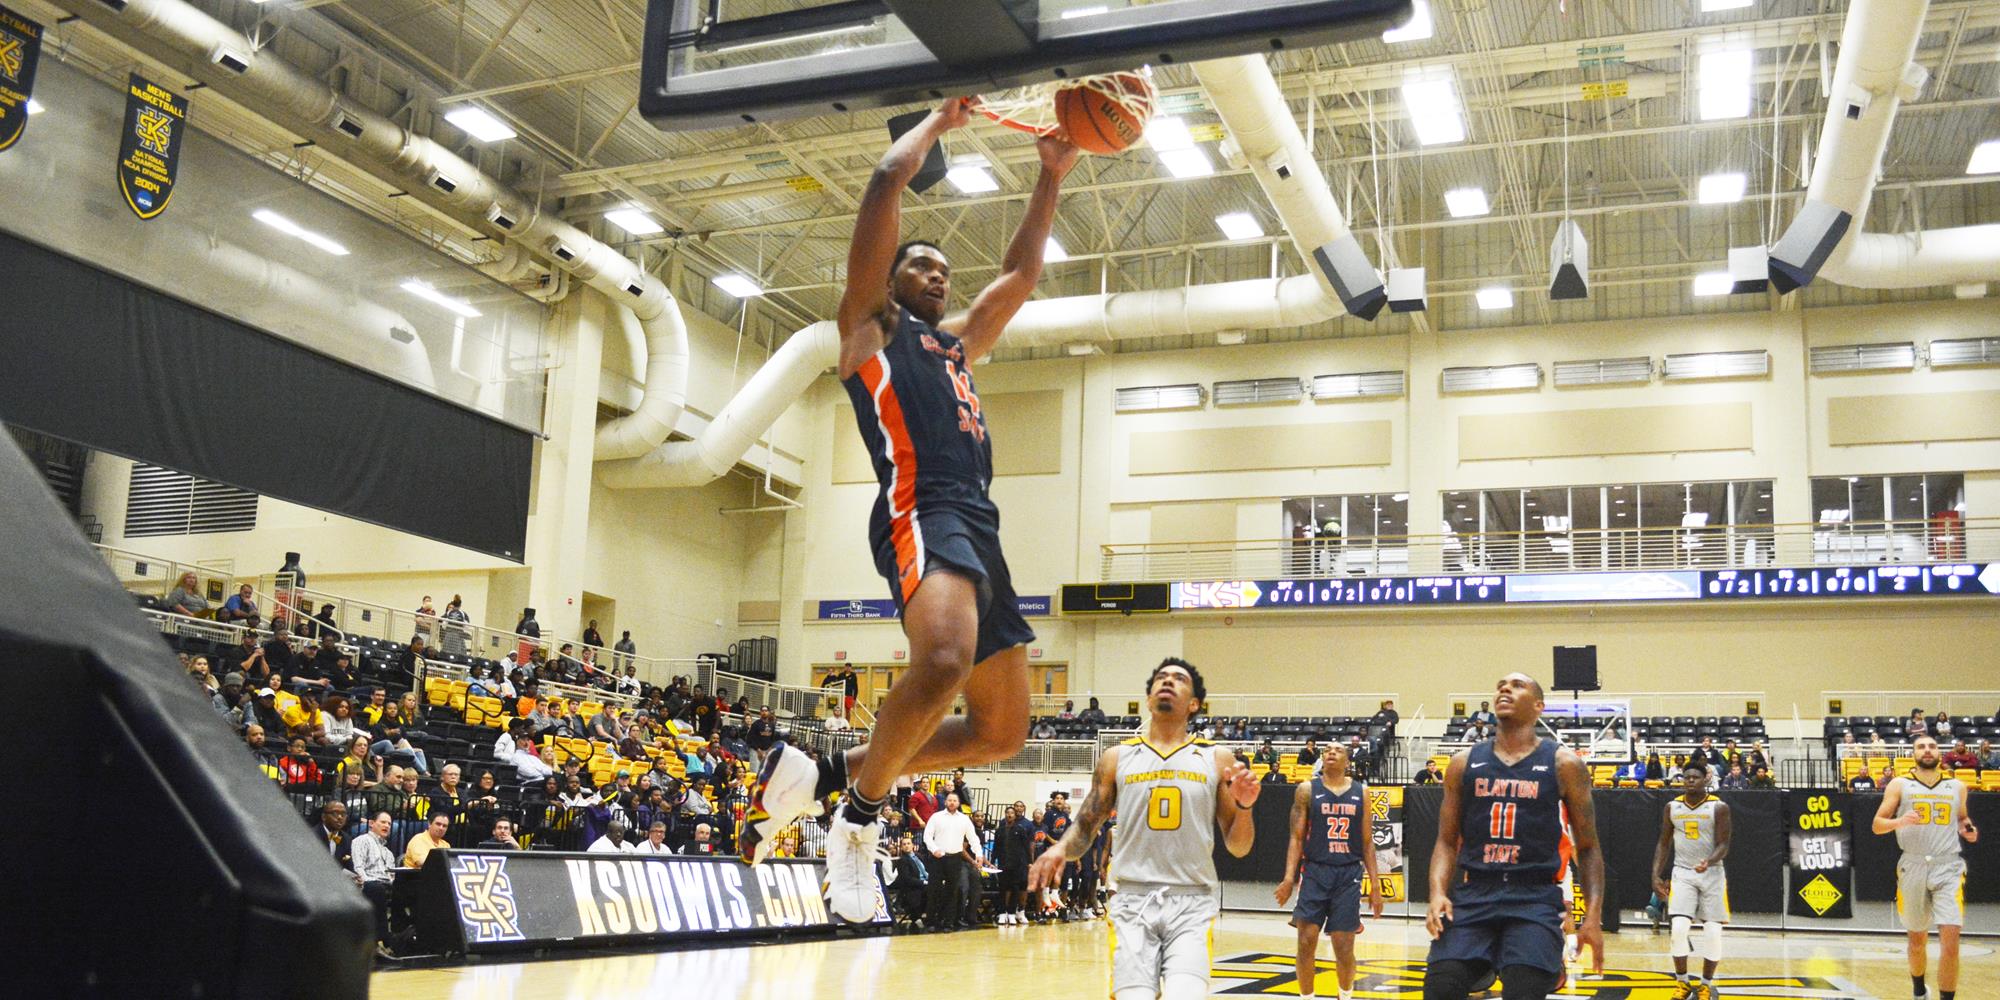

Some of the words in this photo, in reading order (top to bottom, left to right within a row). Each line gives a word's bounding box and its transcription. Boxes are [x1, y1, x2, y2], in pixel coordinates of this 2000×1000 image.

[131, 86, 185, 119] BASKETBALL
[134, 176, 160, 194] 2004
[1431, 587, 1439, 599] 1
[1893, 576, 1906, 591] 2
[1018, 602, 1046, 611] thletics
[1177, 770, 1208, 785] STATE
[1475, 777, 1539, 799] CLAYTON
[1147, 785, 1182, 831] 0
[1806, 795, 1830, 813] GO
[1912, 801, 1952, 826] 33
[1326, 817, 1351, 840] 22
[1490, 802, 1517, 840] 11
[1684, 820, 1700, 840] 5
[1799, 810, 1843, 830] OWLS
[1483, 844, 1521, 865] STATE
[1802, 838, 1827, 854] GET
